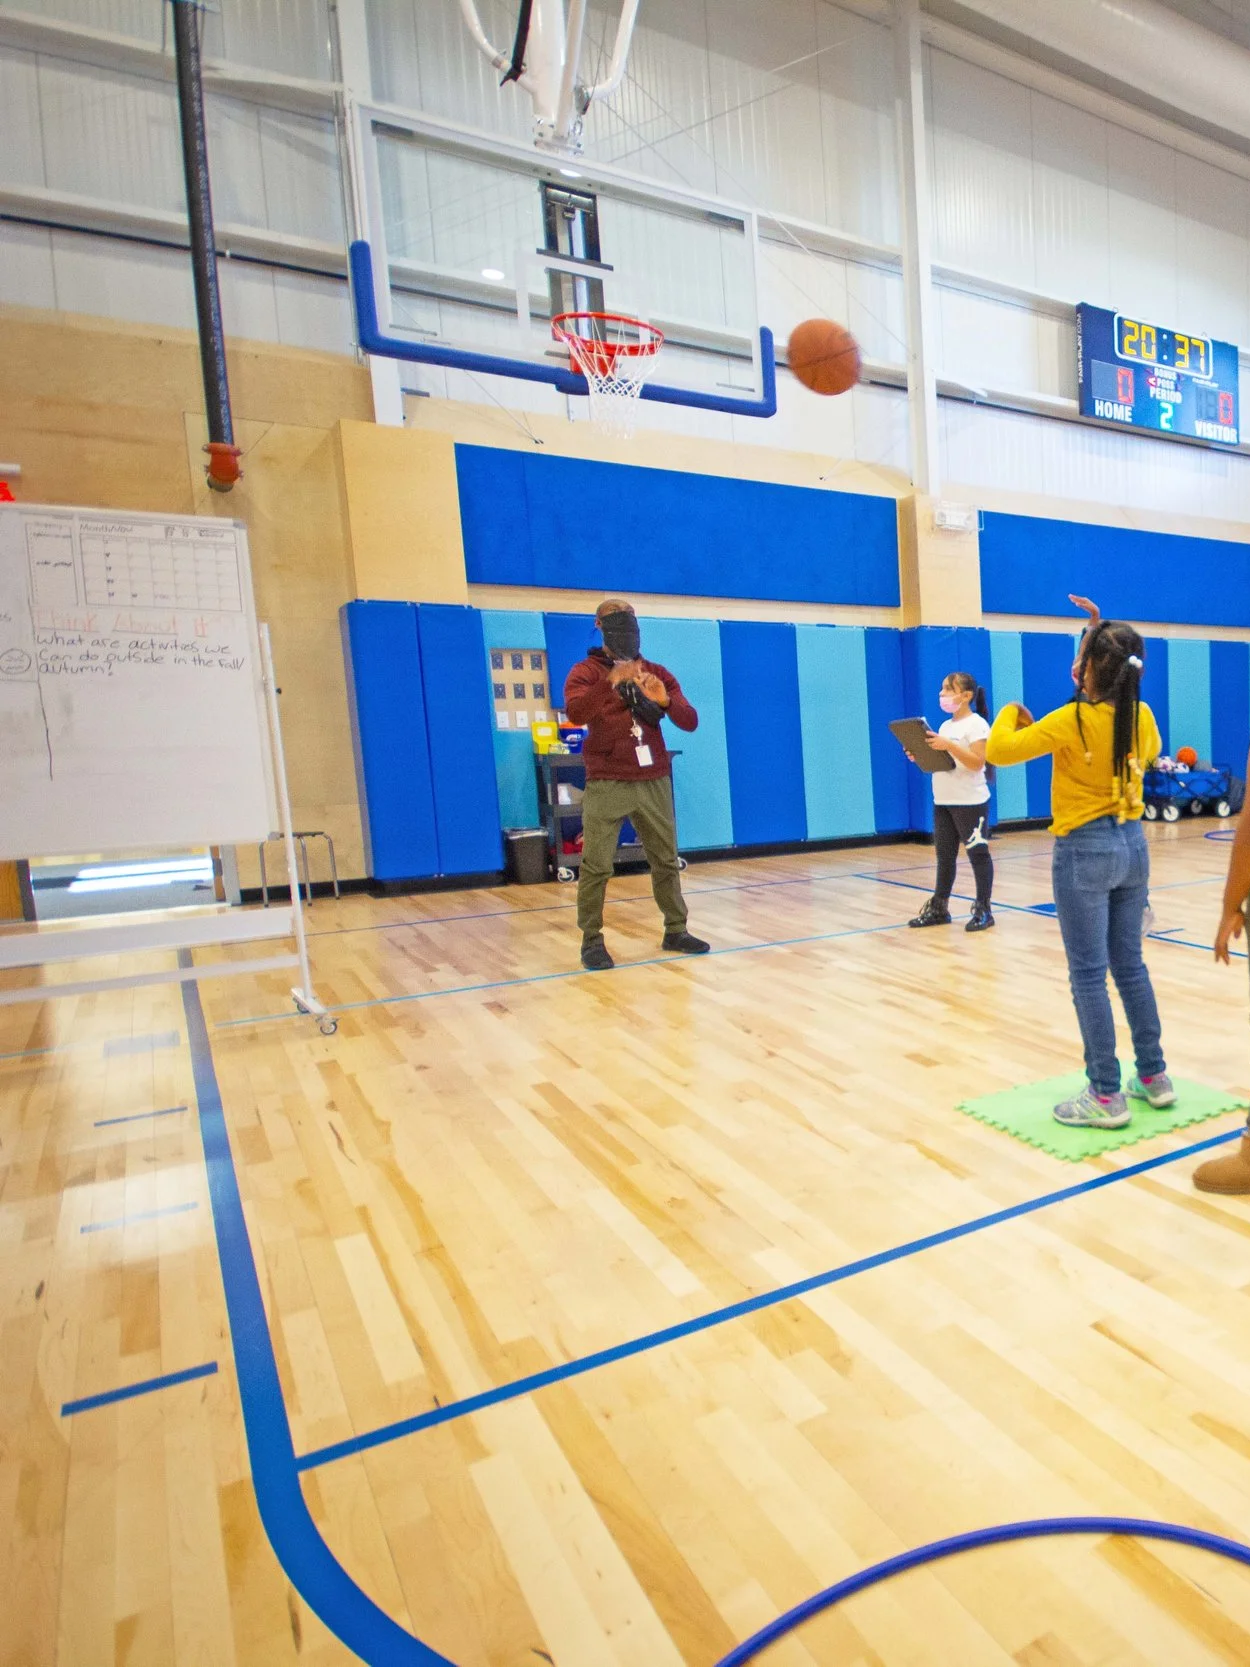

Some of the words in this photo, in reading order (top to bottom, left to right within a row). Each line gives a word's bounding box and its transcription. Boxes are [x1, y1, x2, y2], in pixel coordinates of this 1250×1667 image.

[1123, 320, 1205, 372] 20:37
[1117, 367, 1134, 404] 0
[1150, 387, 1182, 404] PERIOD
[1094, 399, 1133, 422] HOME
[1160, 402, 1174, 430] 2
[1218, 391, 1234, 425] 0
[1194, 420, 1237, 442] VISITOR
[36, 631, 84, 646] What
[91, 638, 120, 649] are
[204, 645, 232, 654] we
[79, 650, 99, 662] do
[173, 654, 188, 665] in
[193, 653, 215, 667] the
